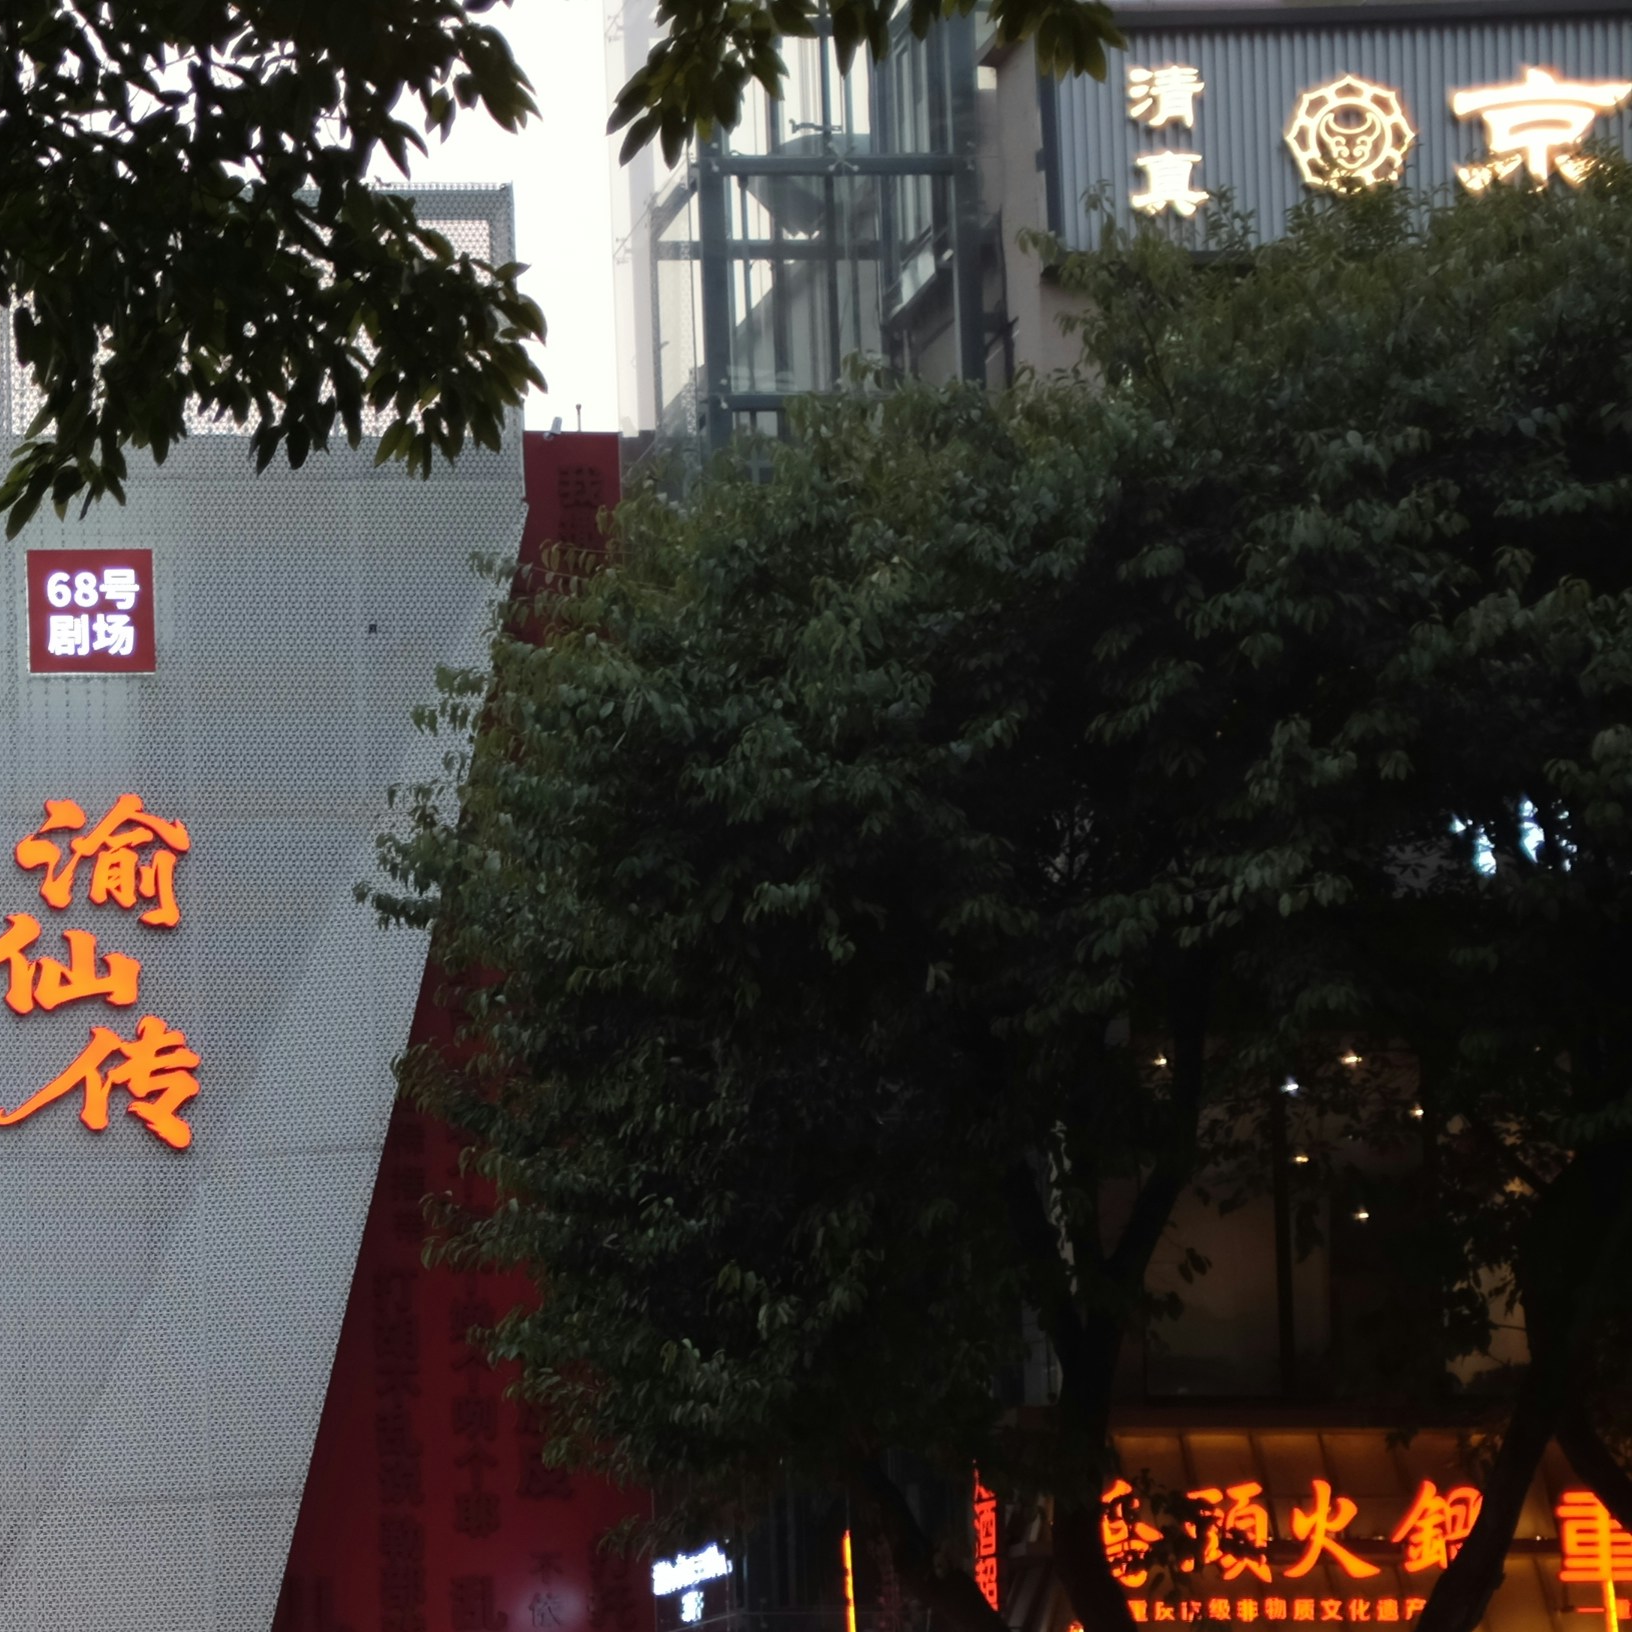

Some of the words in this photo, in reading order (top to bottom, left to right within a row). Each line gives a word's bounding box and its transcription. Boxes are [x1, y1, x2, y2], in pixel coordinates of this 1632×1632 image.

[1128, 61, 1208, 218] 清真
[45, 568, 140, 606] 68号
[46, 613, 137, 657] 剧场
